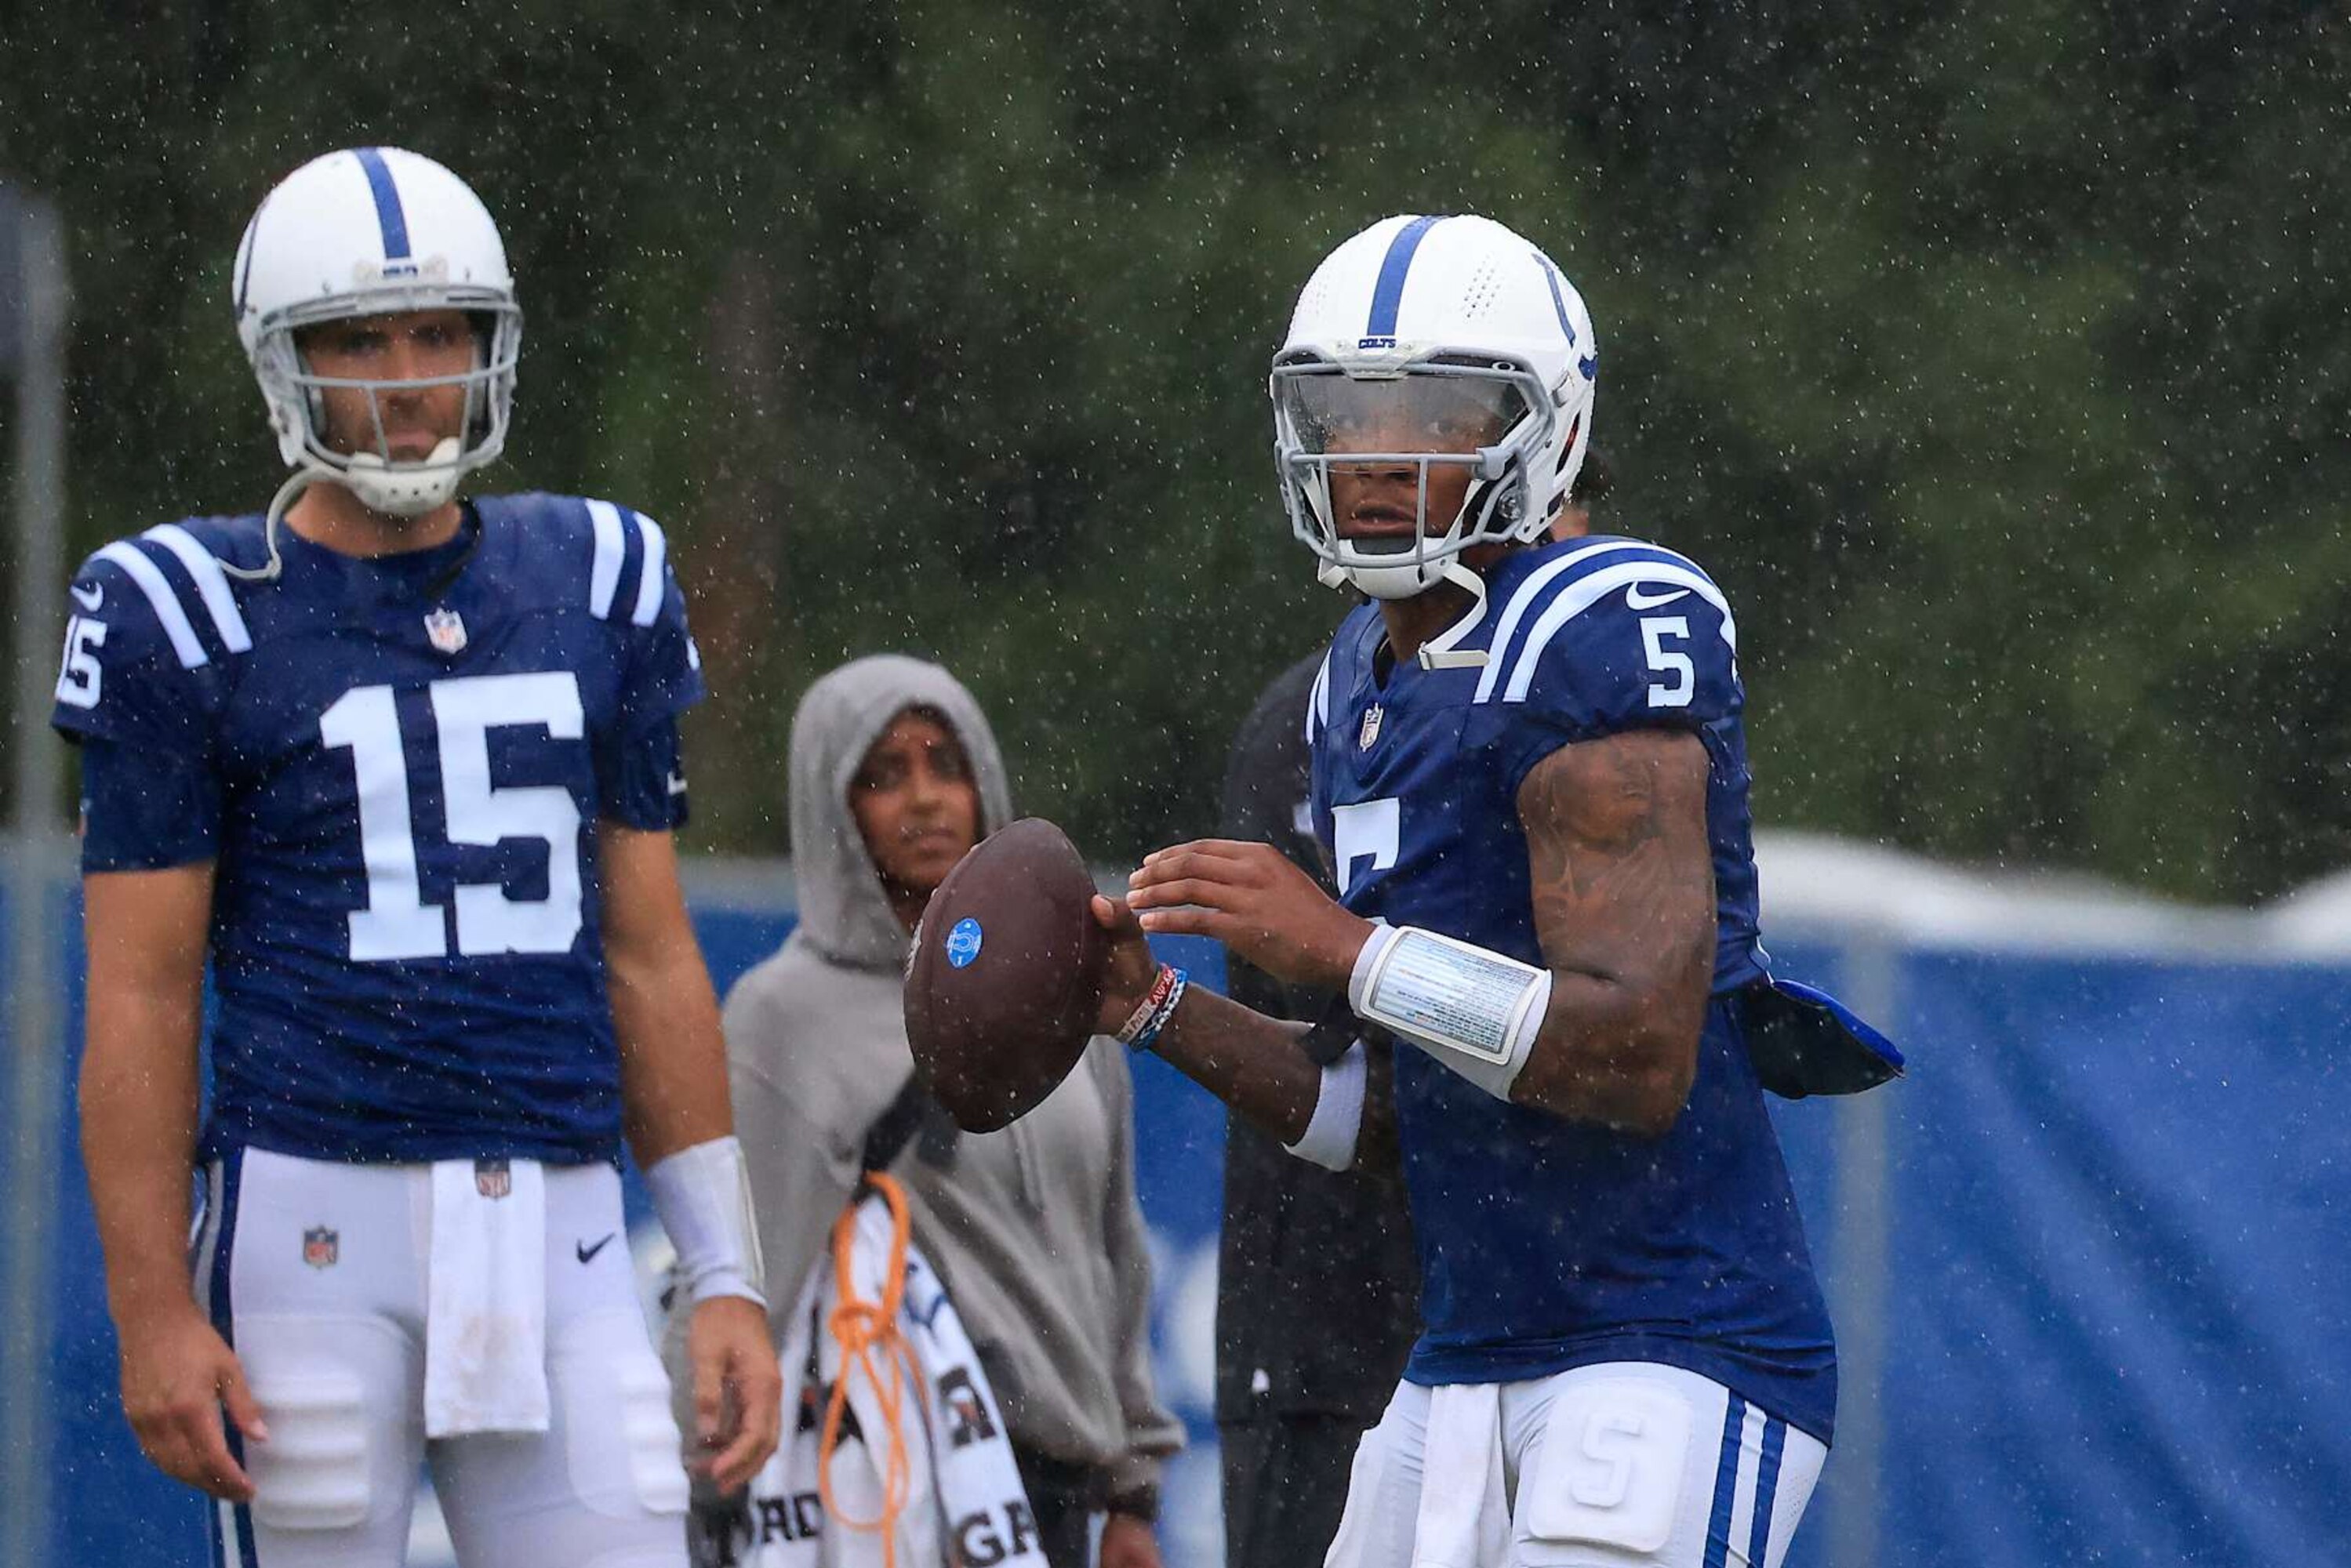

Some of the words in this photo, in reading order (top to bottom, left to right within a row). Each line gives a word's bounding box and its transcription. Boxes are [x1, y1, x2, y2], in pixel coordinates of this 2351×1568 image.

[1358, 337, 1396, 349] COLTS
[1640, 615, 1695, 707] 5
[320, 671, 585, 961] 15
